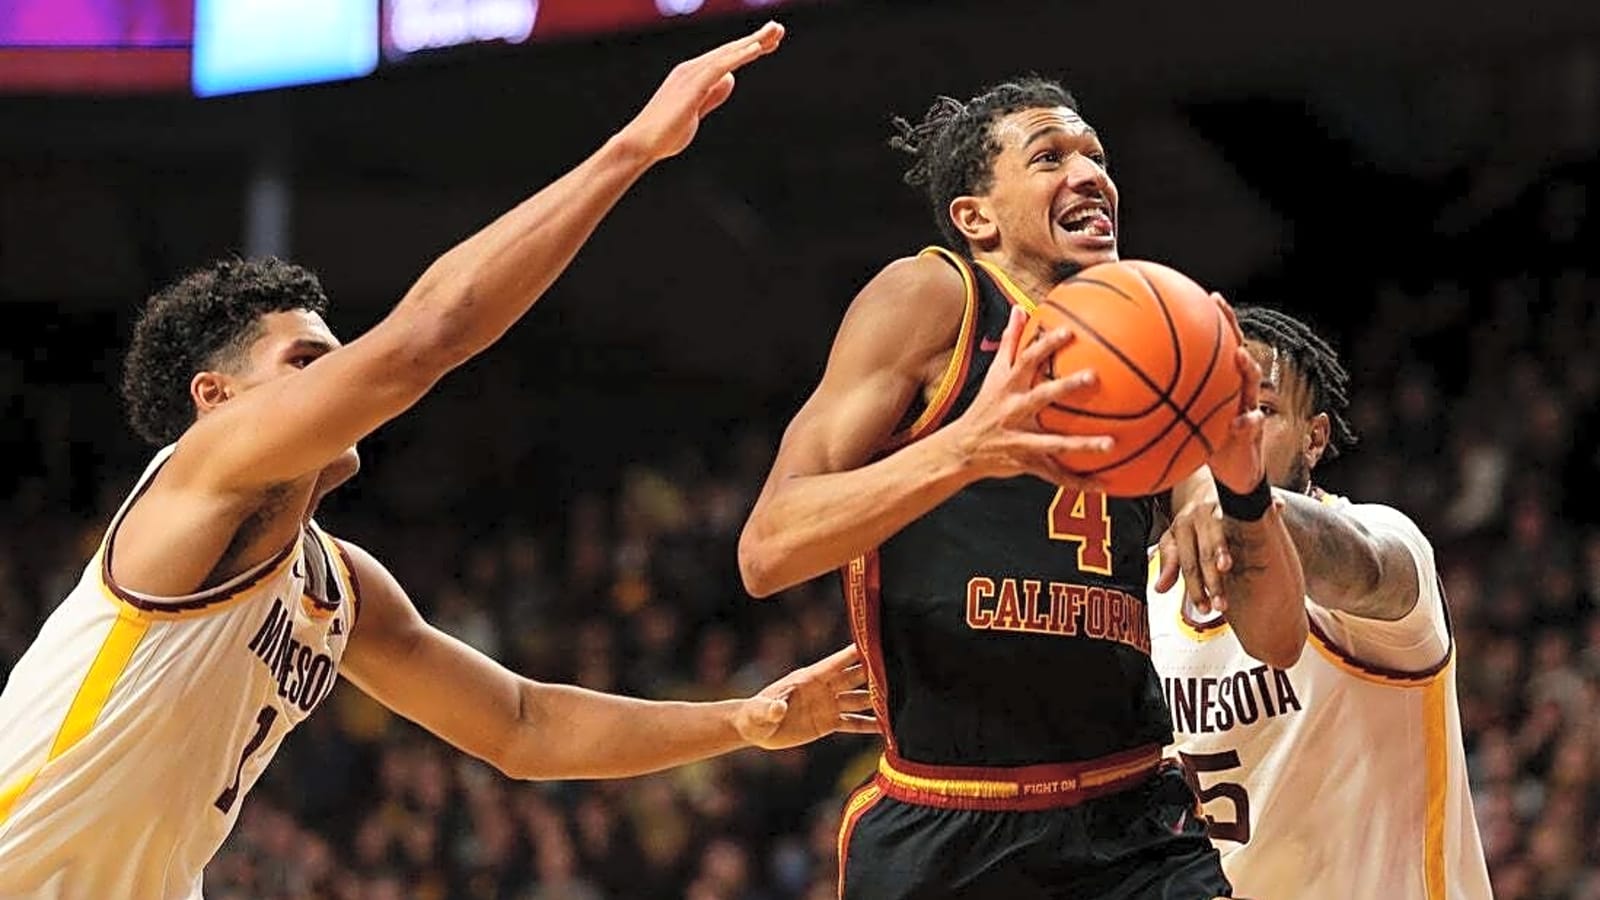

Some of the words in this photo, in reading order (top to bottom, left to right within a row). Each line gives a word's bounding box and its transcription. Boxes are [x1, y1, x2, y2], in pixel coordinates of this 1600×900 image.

[1048, 484, 1112, 576] 4
[215, 704, 278, 815] 1
[1024, 782, 1058, 795] FIGHT
[1061, 779, 1076, 792] ON
